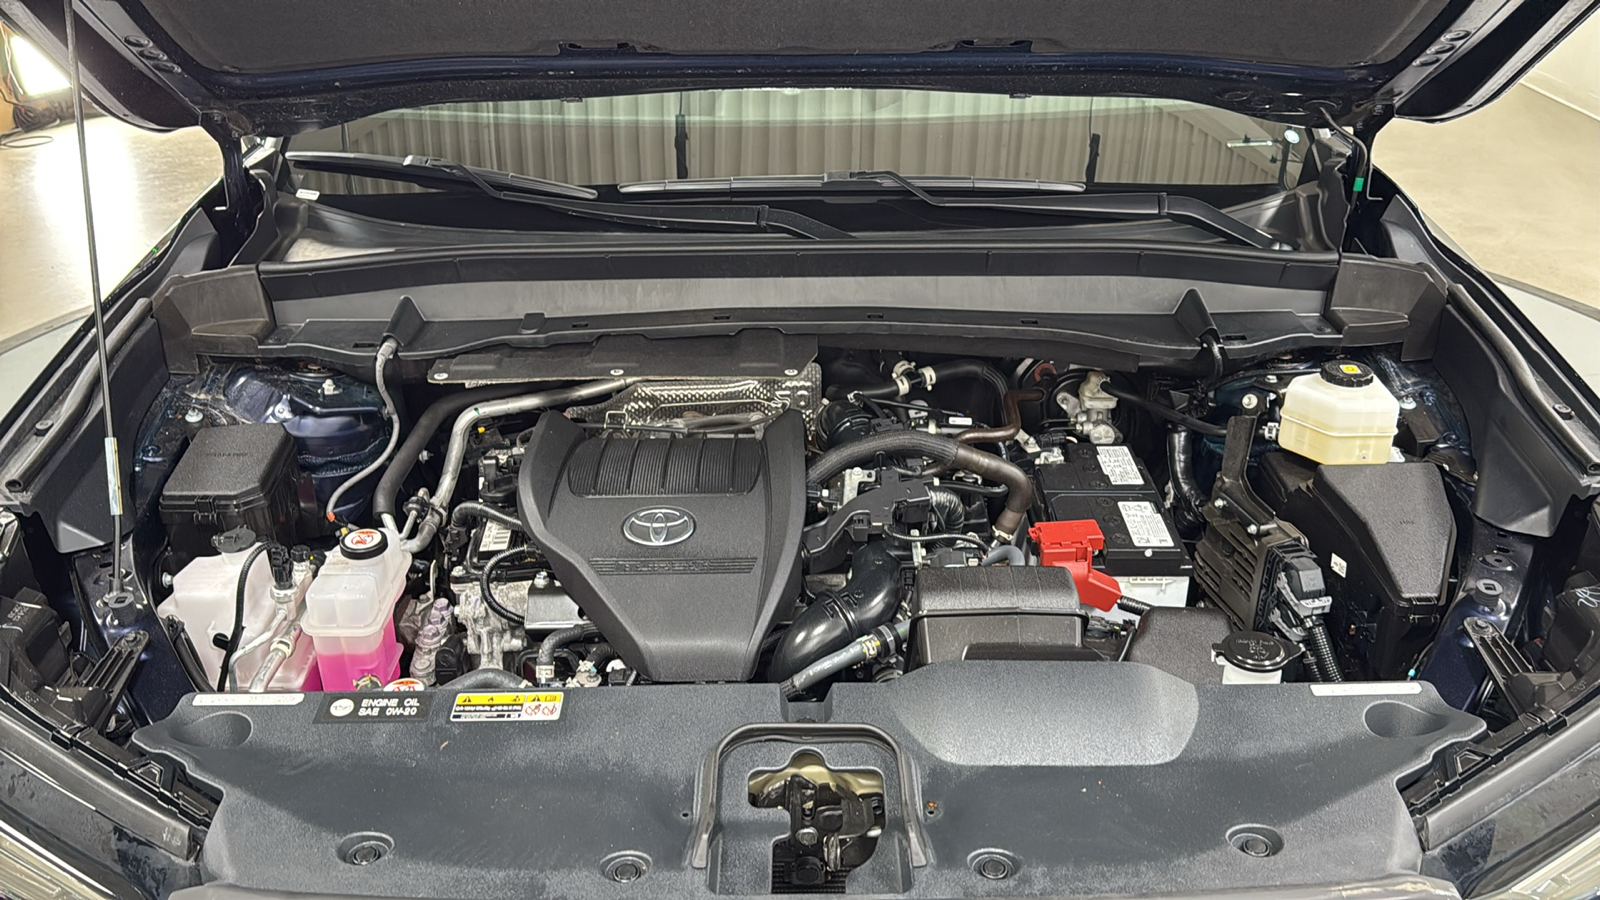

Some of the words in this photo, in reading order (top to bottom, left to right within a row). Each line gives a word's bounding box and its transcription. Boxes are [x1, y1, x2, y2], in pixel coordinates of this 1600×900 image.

[361, 698, 399, 707] ENGINE
[403, 698, 420, 706] OIL
[358, 707, 380, 716] SAE
[385, 707, 418, 716] 0W-20
